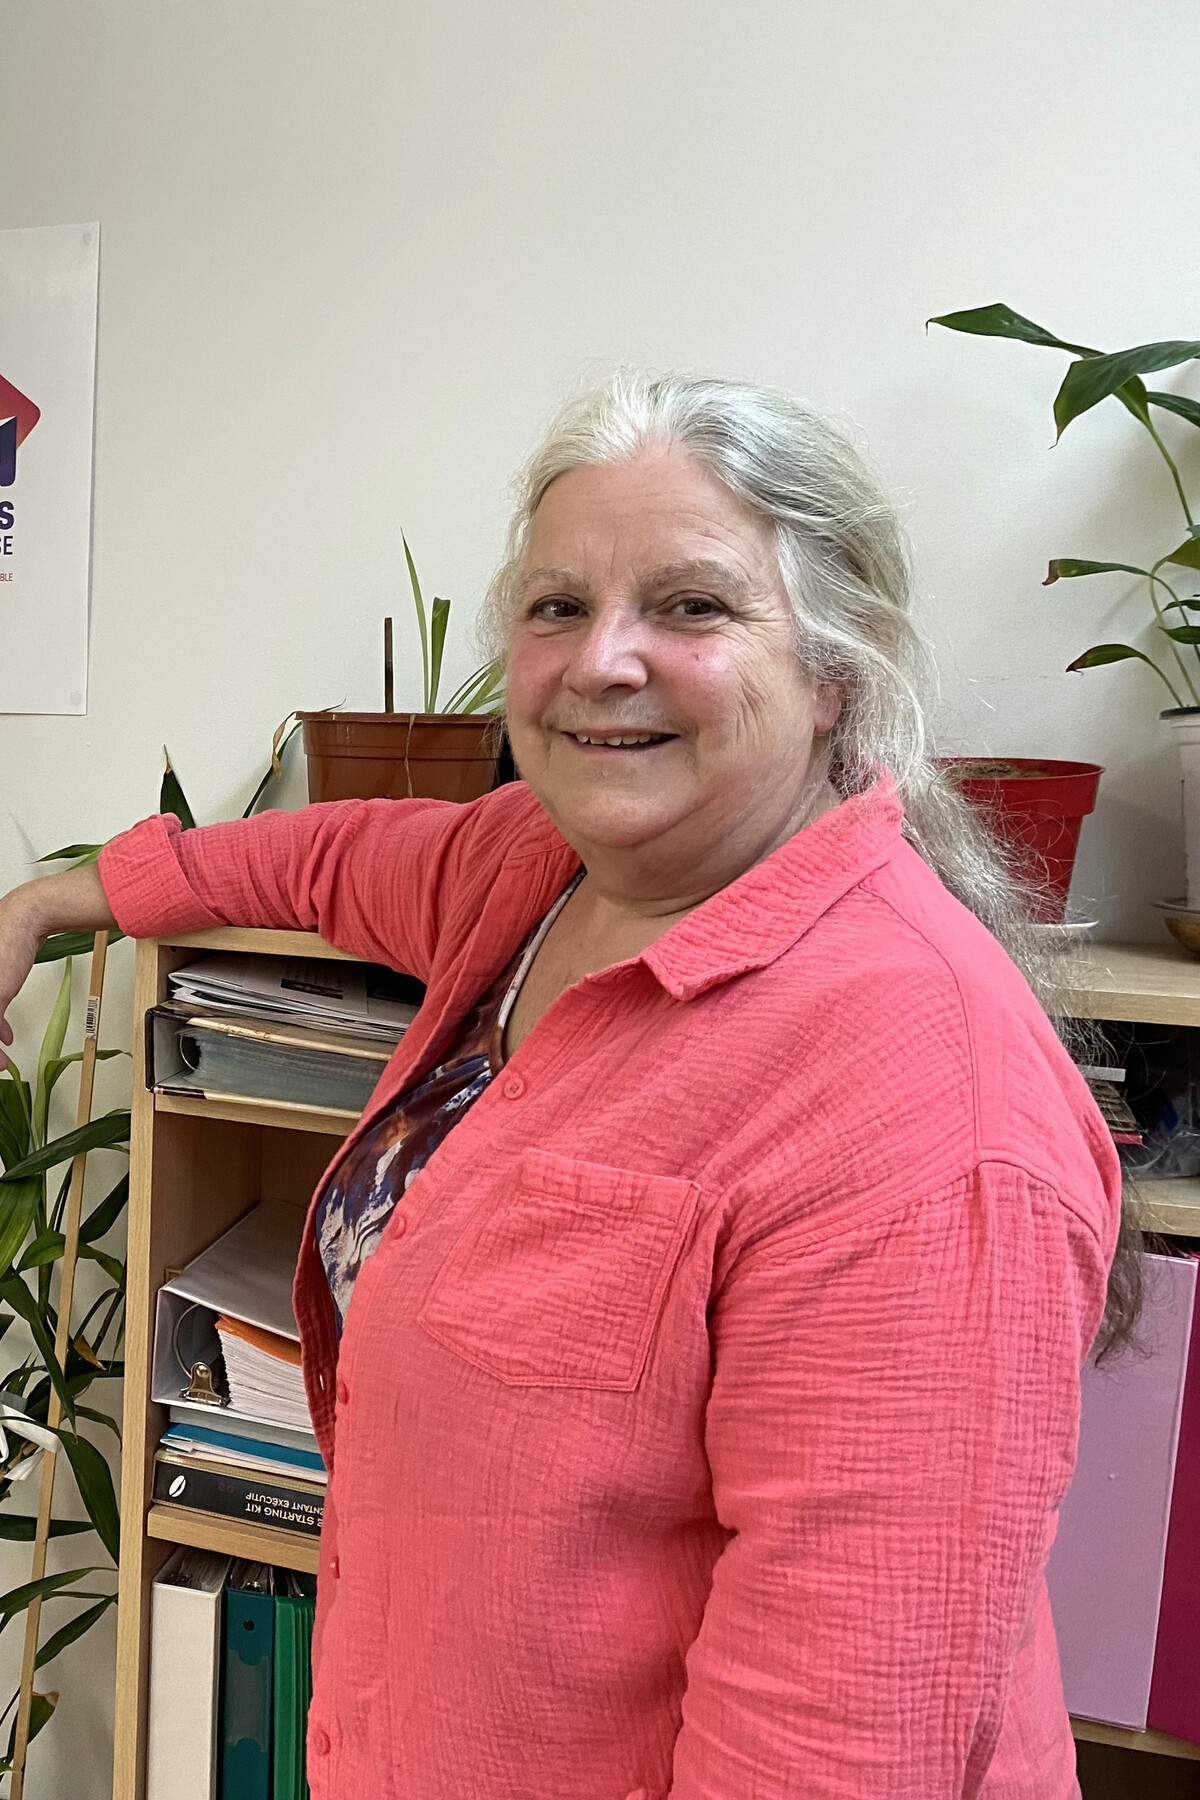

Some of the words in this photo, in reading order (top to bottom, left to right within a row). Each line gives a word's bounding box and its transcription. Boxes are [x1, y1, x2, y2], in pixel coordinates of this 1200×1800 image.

[244, 1502, 262, 1514] KIT
[245, 1492, 290, 1508] EXÉCUTIF
[263, 1507, 315, 1526] STARTING
